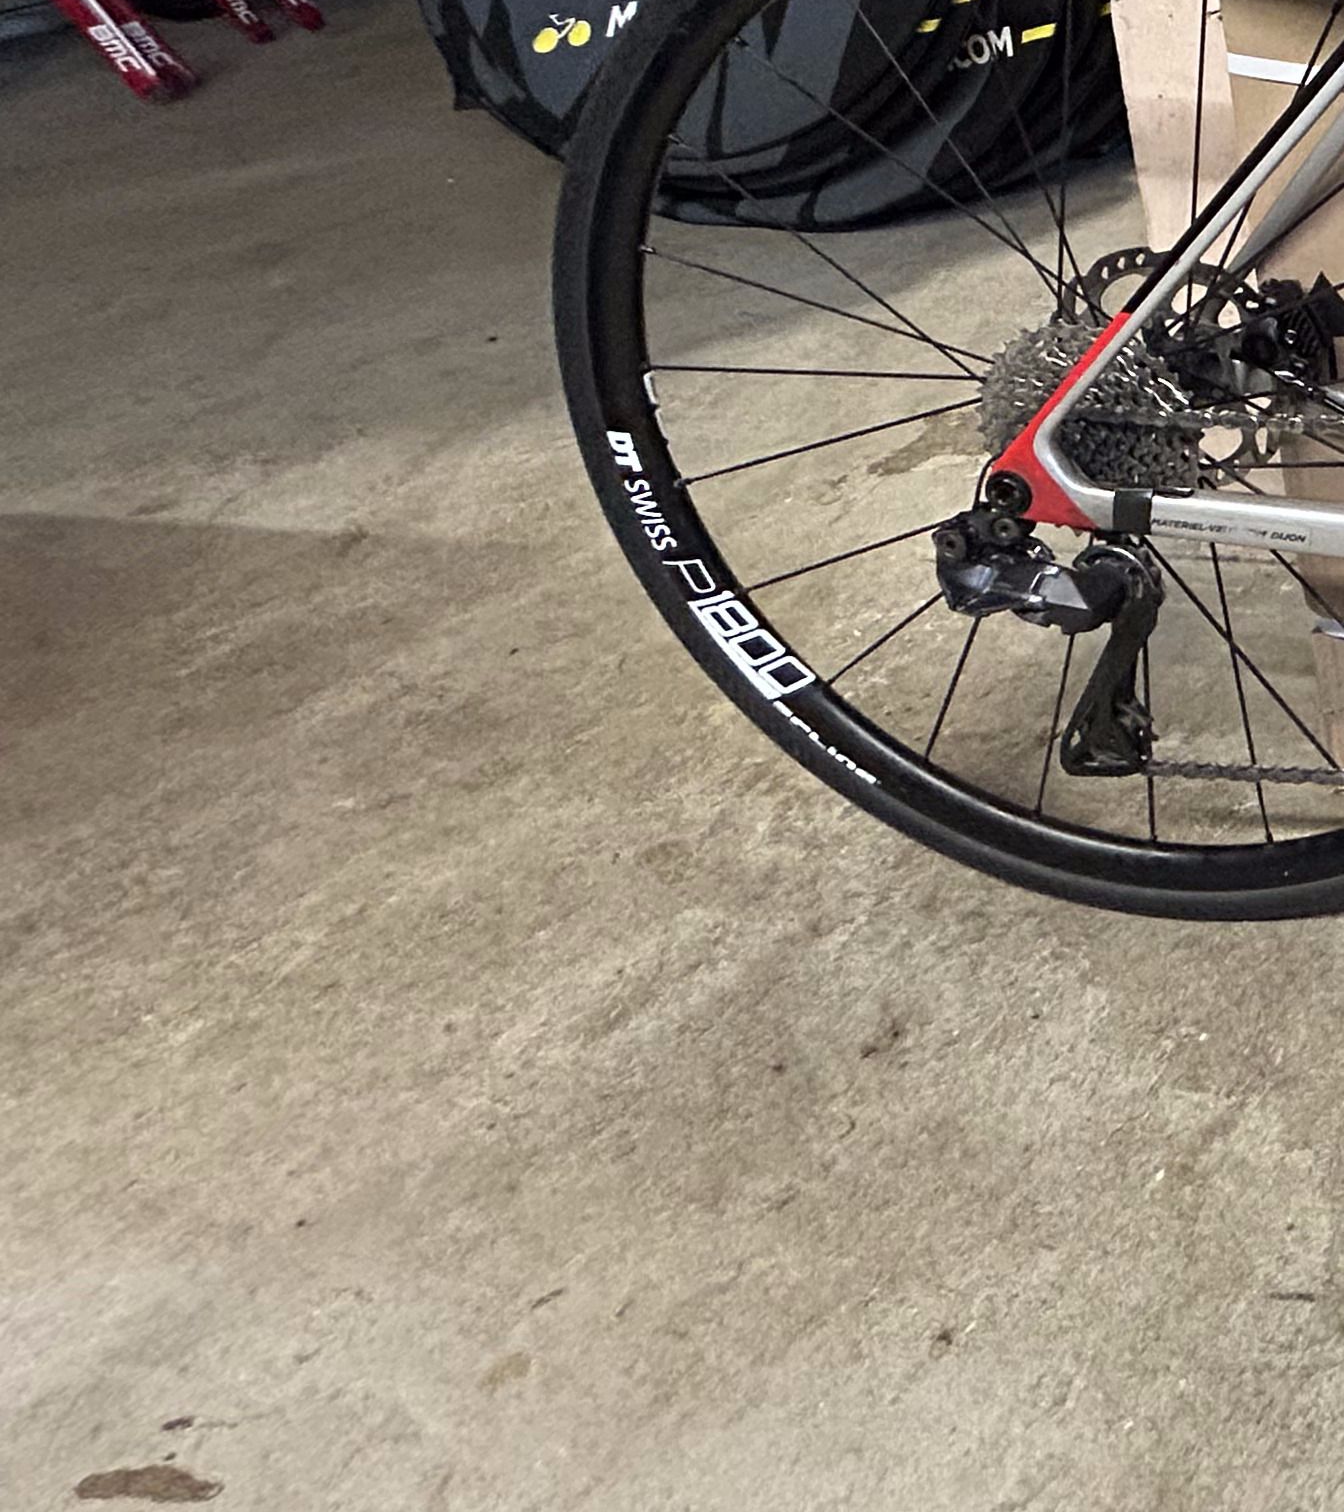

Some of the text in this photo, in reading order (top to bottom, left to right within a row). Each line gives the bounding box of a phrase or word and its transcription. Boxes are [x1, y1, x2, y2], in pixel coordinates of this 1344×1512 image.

[87, 25, 142, 73] BMC
[121, 21, 174, 67] BMC
[606, 430, 644, 473] DT
[623, 478, 678, 552] SWISS
[1270, 530, 1307, 543] DIJON
